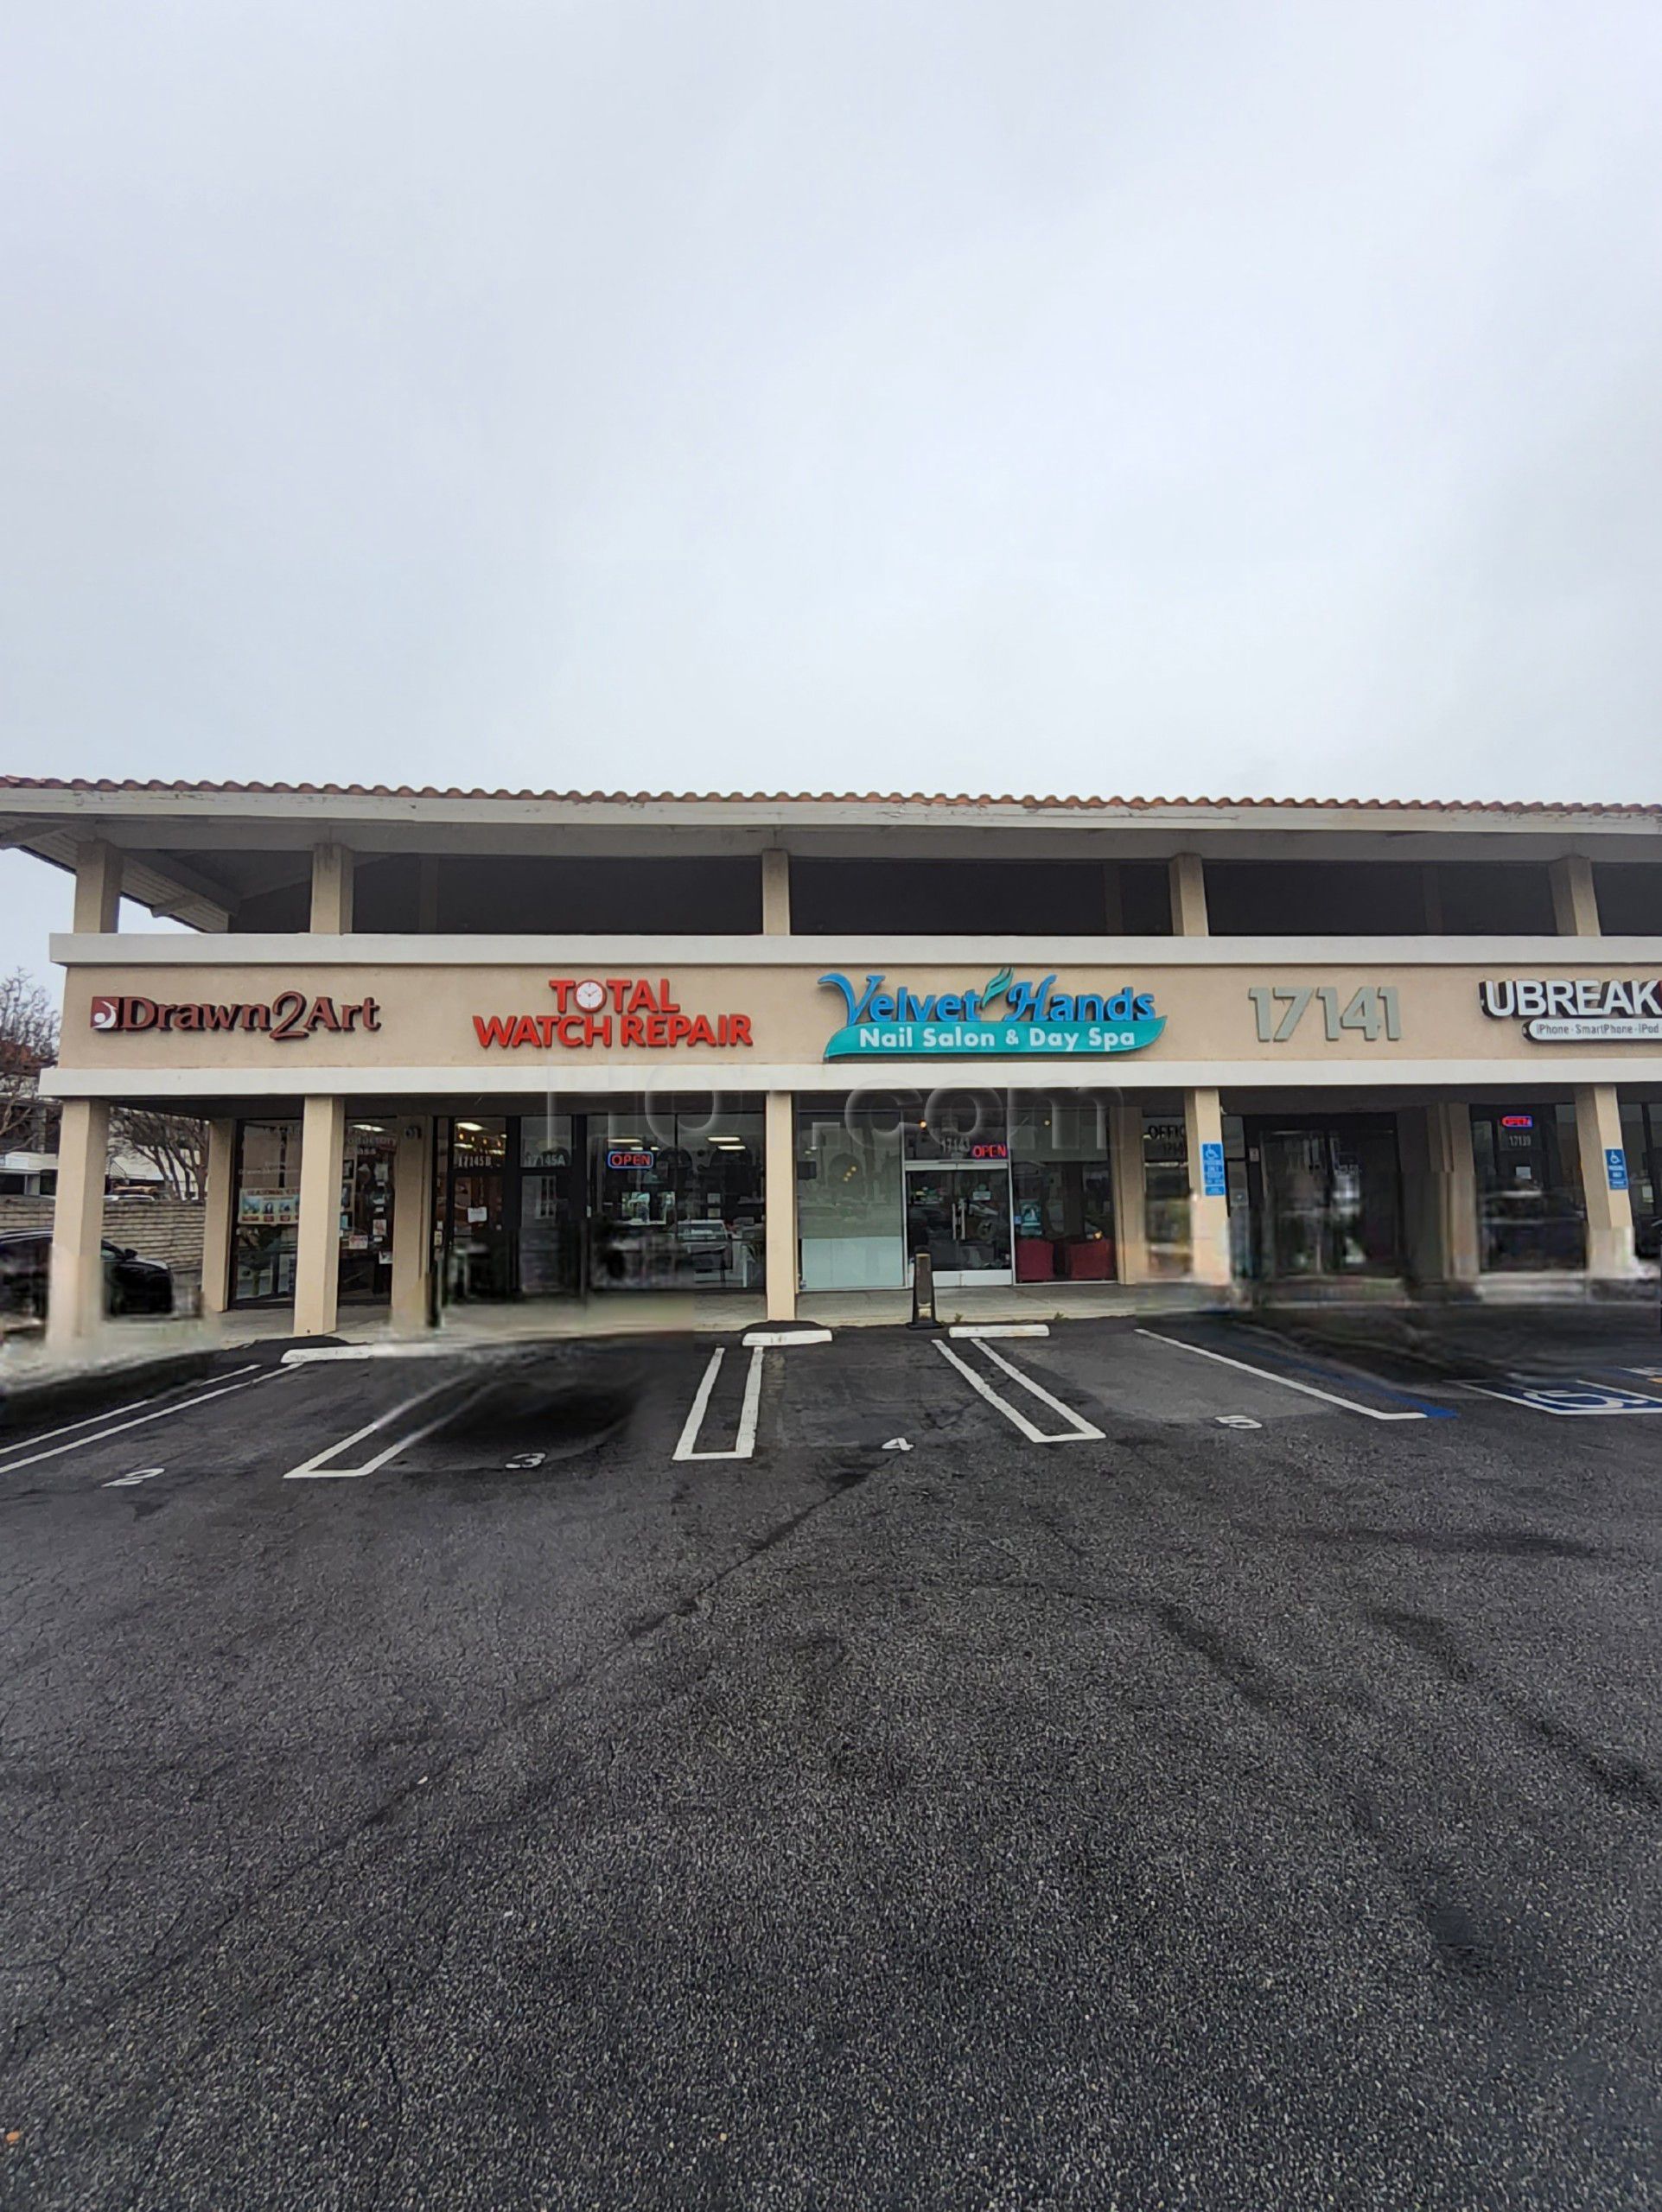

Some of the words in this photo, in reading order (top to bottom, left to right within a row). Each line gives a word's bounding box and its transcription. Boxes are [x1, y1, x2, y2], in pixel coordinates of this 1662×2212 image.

[549, 978, 680, 1014] TOTAL
[818, 973, 981, 1024] Velvet
[1003, 974, 1156, 1023] Hands
[1480, 979, 1662, 1017] UBREAK
[120, 990, 382, 1040] Drawn2Art
[1248, 986, 1403, 1043] 17141
[473, 1014, 612, 1048] WATCH
[621, 1014, 753, 1048] REPAIR
[1536, 1023, 1569, 1035] iPhone
[1576, 1023, 1633, 1035] SmartPhone
[1638, 1023, 1659, 1035] iPod
[859, 1027, 913, 1048] Nail
[923, 1027, 996, 1047] Salon
[1006, 1029, 1020, 1046] &
[1029, 1029, 1079, 1052] Day
[1088, 1027, 1136, 1052] Spa
[458, 1154, 492, 1167] 17145B
[523, 1154, 565, 1166] 17145A
[610, 1154, 652, 1167] OPEN
[972, 1145, 1007, 1159] OPEN
[1215, 1414, 1264, 1429] 5
[882, 1436, 914, 1451] 4
[504, 1452, 546, 1471] 3
[102, 1467, 164, 1488] 2
